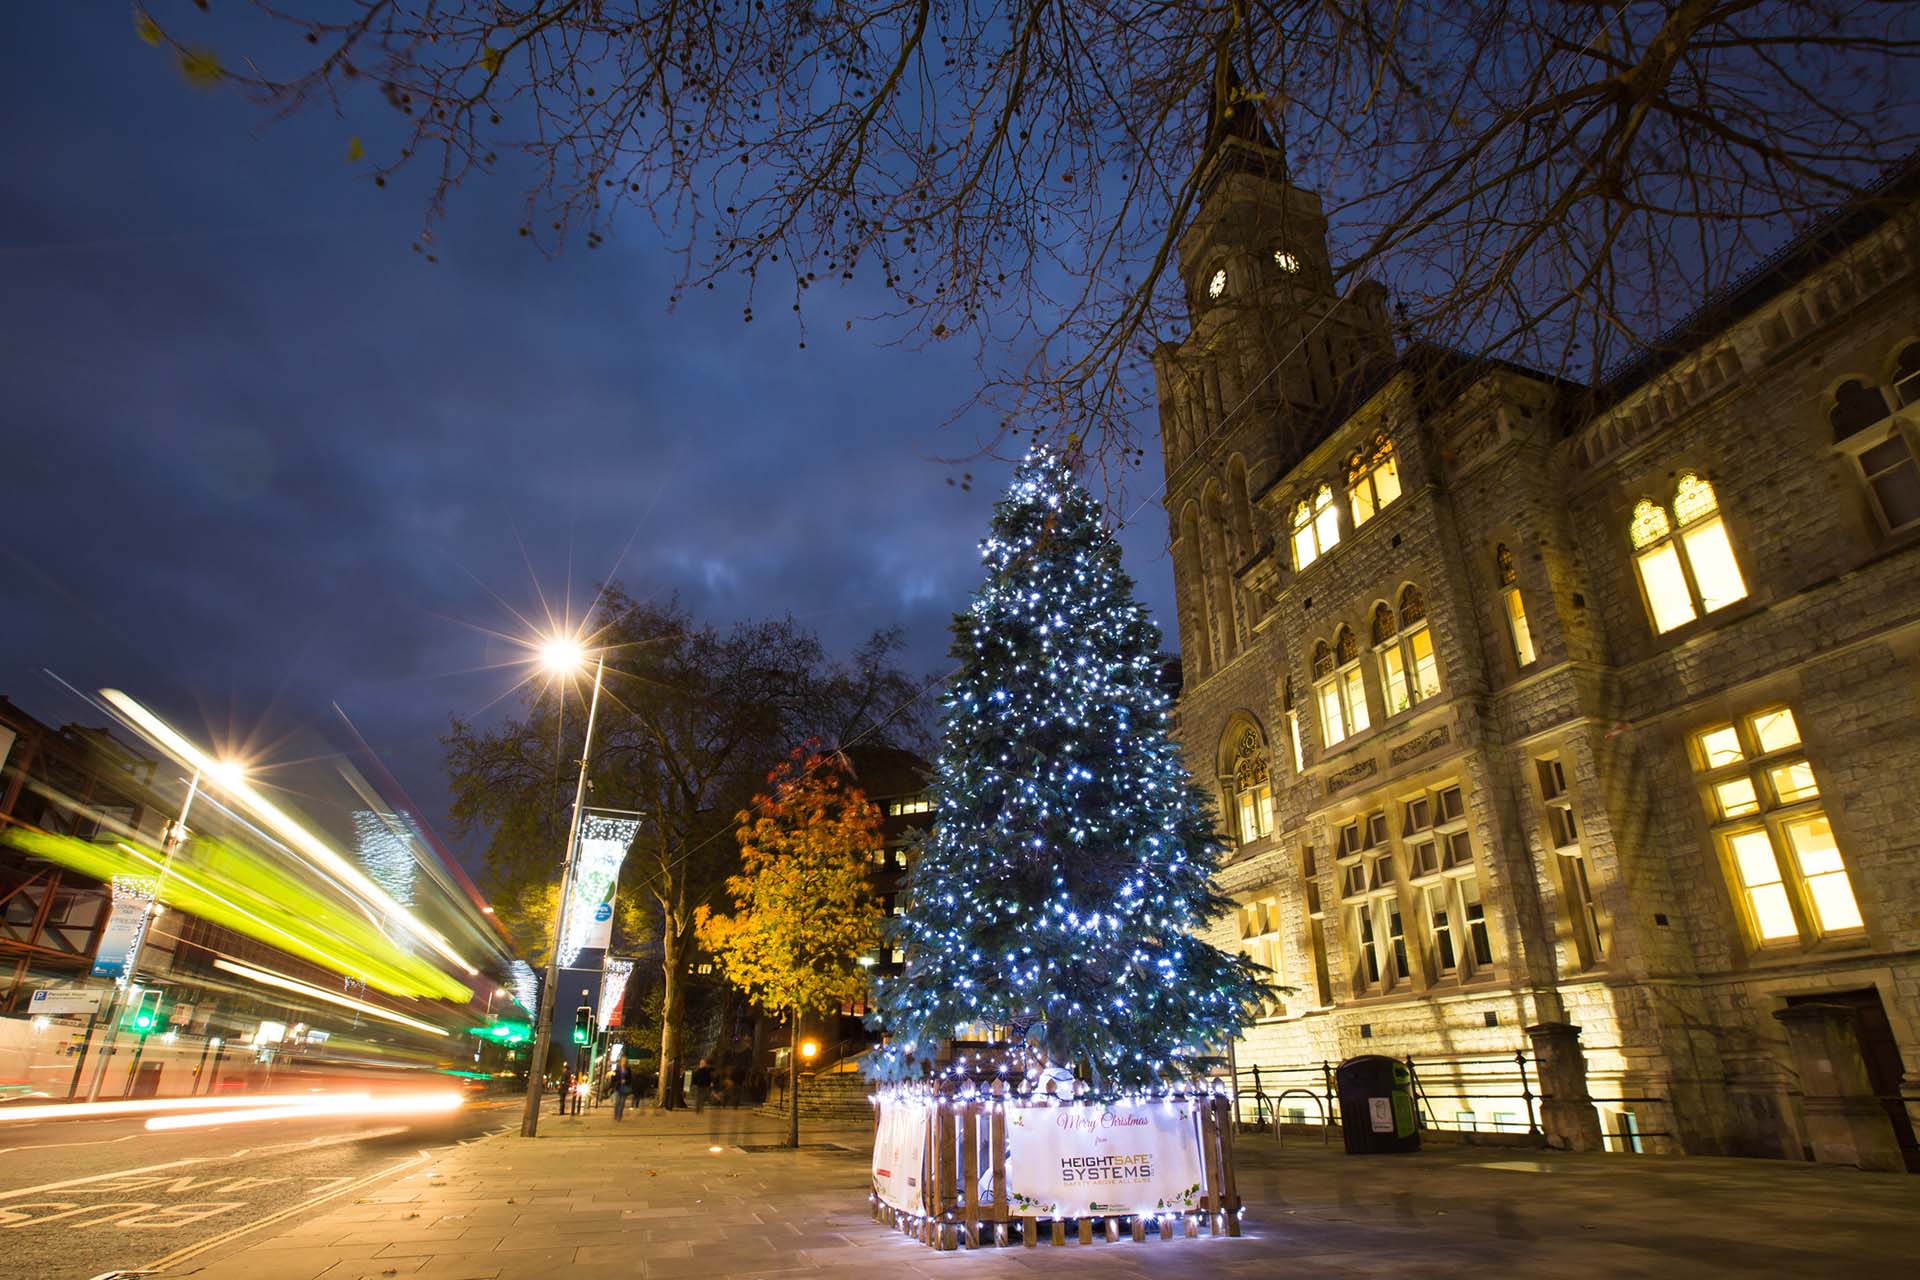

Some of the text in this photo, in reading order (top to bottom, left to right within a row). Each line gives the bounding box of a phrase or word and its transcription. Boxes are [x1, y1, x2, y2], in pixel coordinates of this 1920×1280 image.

[1057, 1112, 1148, 1133] Merry Christmas
[1061, 1154, 1150, 1168] HEIGHTSAFE
[1062, 1165, 1151, 1181] SYSTEMS
[0, 1202, 249, 1229] BUS
